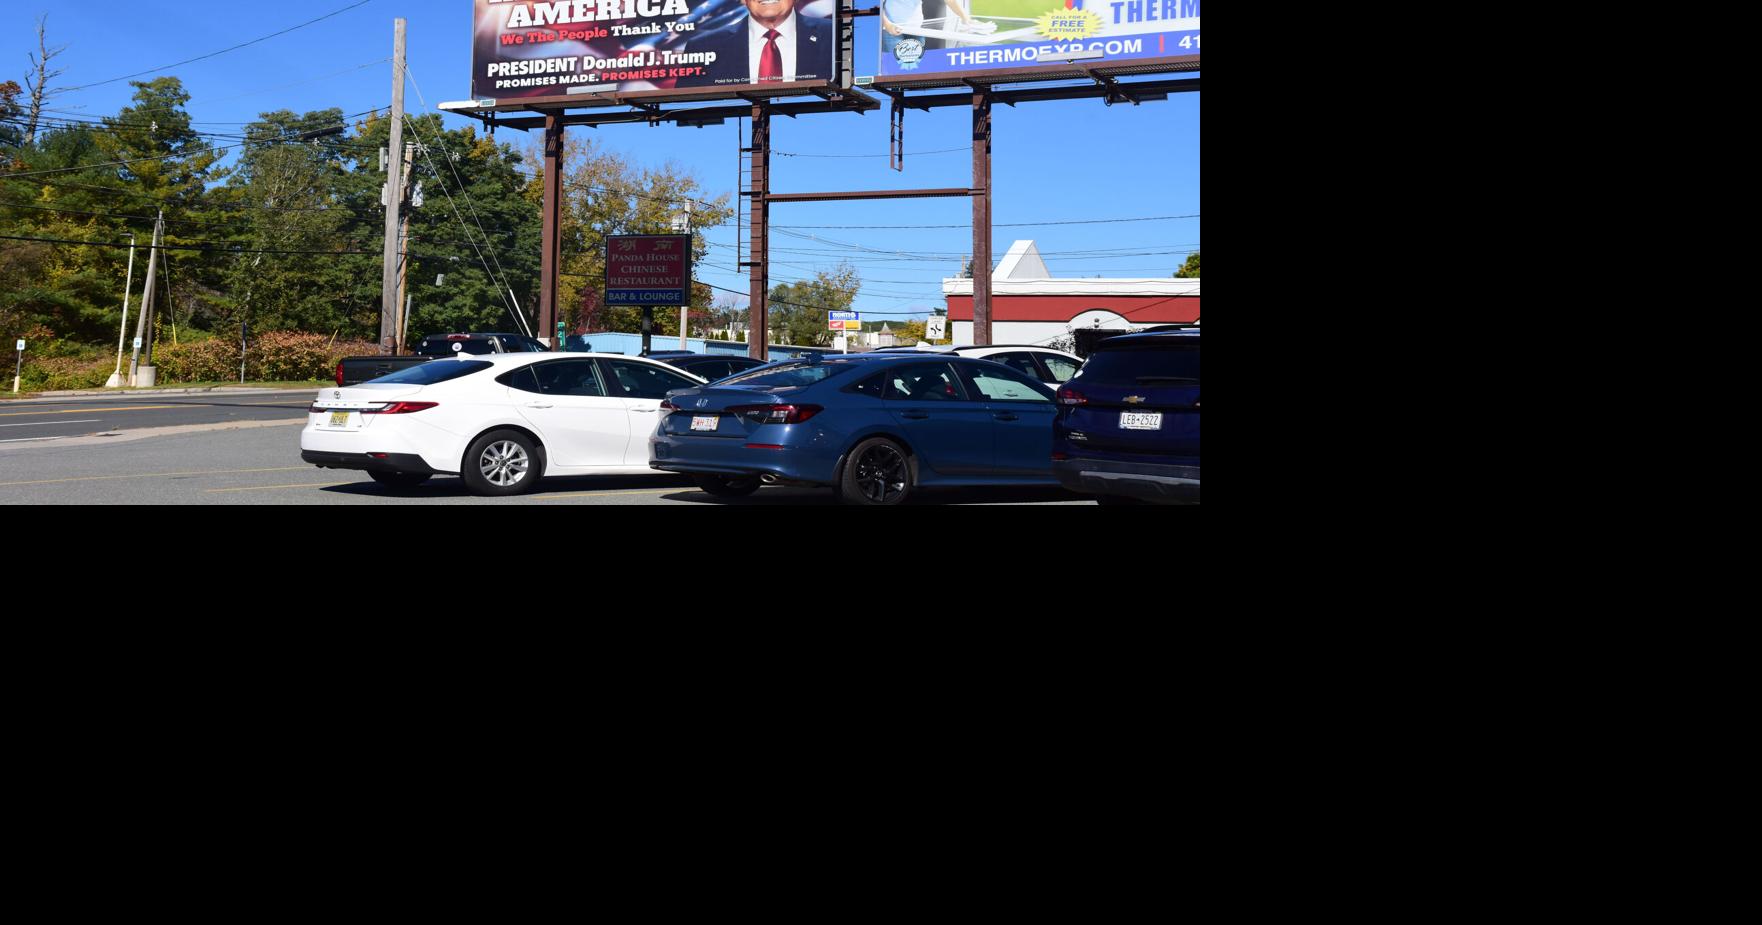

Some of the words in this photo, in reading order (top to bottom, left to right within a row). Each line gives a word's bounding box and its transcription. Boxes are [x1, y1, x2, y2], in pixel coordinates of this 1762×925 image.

[507, 0, 689, 28] AMERICA
[1111, 0, 1200, 24] THERM
[501, 33, 523, 45] We
[527, 32, 555, 43] The
[559, 28, 608, 41] People
[611, 22, 661, 36] Thank
[665, 21, 695, 32] You
[487, 57, 577, 77] PRESIDENT
[583, 53, 644, 70] Donald
[647, 51, 660, 65] J.
[661, 50, 717, 65] Trump
[946, 39, 1142, 65] THERMOEXPCOM
[496, 76, 556, 88] PROMISES
[559, 73, 599, 84] MADE.
[602, 68, 666, 81] PROMISES
[669, 66, 706, 77] KEPT.
[611, 253, 643, 262] PANDA
[646, 253, 679, 261] HOUSE
[620, 265, 669, 273] CHINESE
[610, 277, 680, 285] RESTAURANT
[608, 292, 627, 301] BAR
[629, 292, 636, 301] &
[639, 292, 680, 301] LOUNGE
